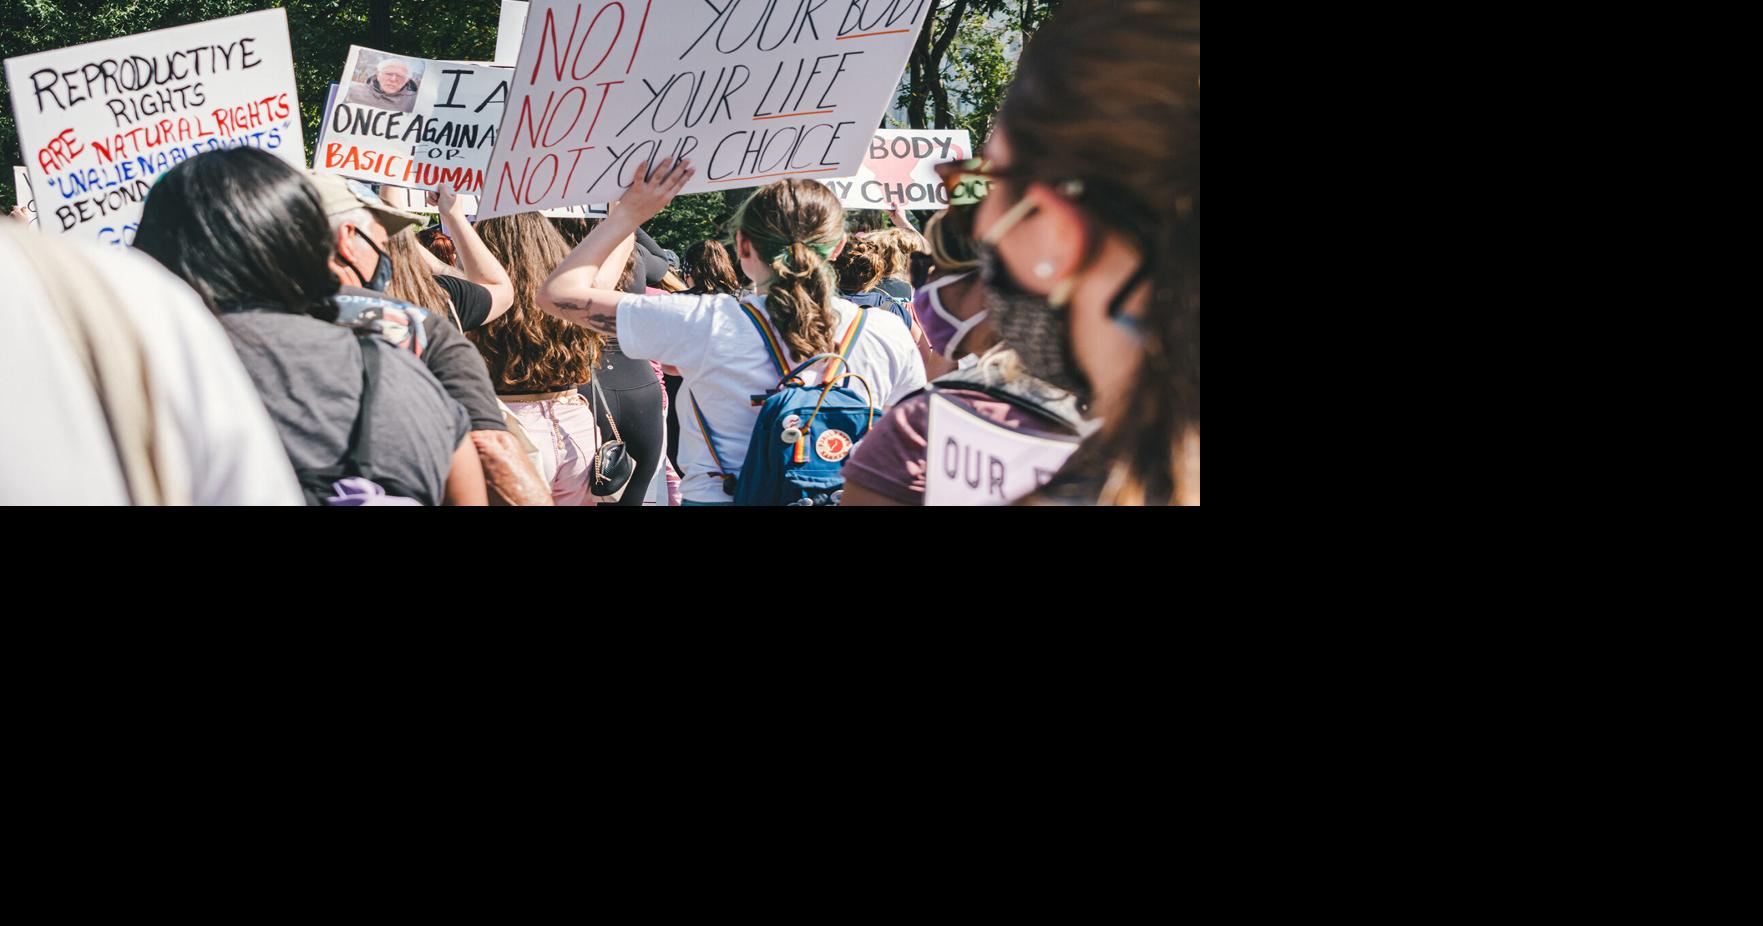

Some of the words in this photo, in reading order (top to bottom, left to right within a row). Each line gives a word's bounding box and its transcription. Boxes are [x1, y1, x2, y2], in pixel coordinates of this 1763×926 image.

[30, 38, 263, 114] REPRODUCTIVE
[433, 69, 474, 108] I
[474, 80, 508, 113] A
[510, 81, 625, 151] NOT
[615, 64, 750, 137] YOUR
[753, 51, 864, 118] LIFE
[106, 83, 206, 127] RIGHTS
[332, 103, 403, 140] ONCE
[401, 114, 479, 149] AGAIN
[38, 128, 85, 175] ARE
[91, 115, 214, 165] NATURAL
[211, 93, 291, 137] RIGHTS
[869, 136, 952, 160] BODY
[325, 143, 397, 178] BASIC
[493, 145, 596, 212] NOT
[586, 135, 699, 193] YOUR
[708, 121, 856, 181] CHOICE
[56, 180, 151, 232] BEYOND
[943, 436, 1006, 498] OUR
